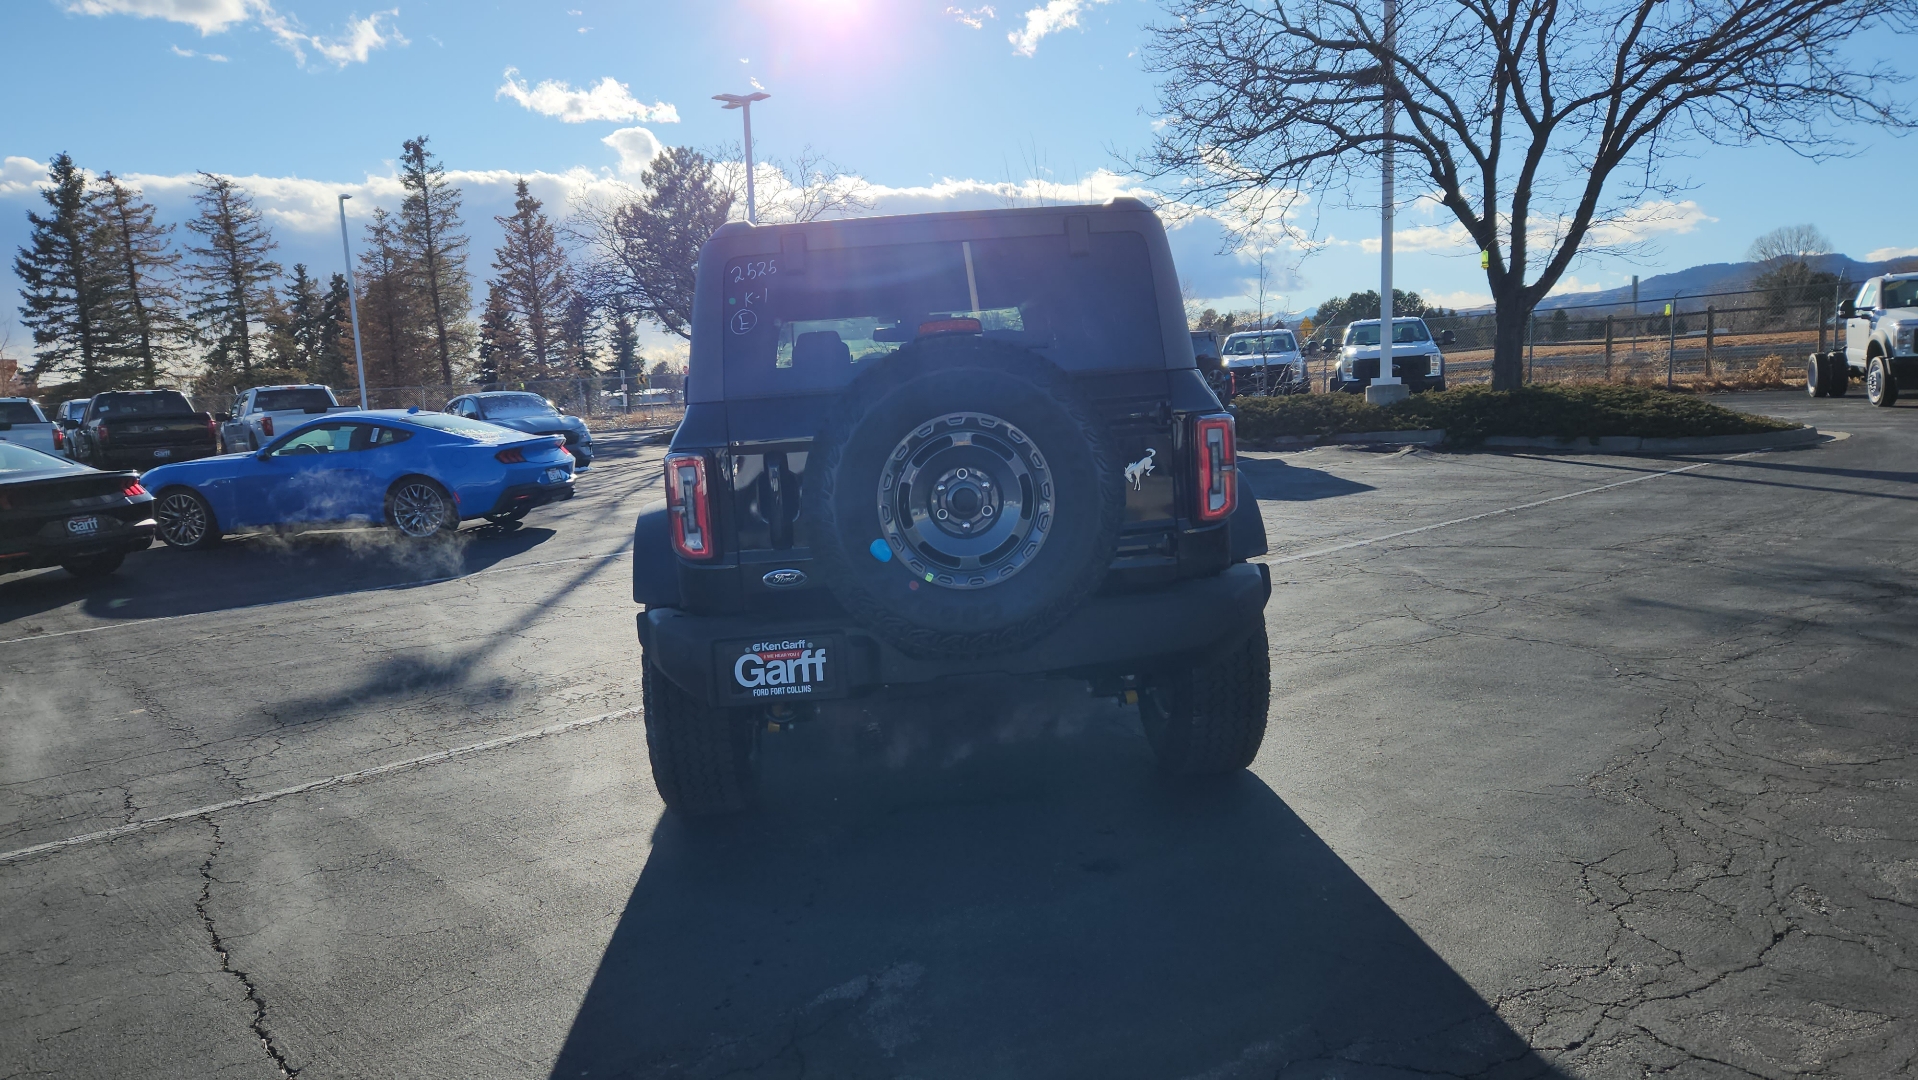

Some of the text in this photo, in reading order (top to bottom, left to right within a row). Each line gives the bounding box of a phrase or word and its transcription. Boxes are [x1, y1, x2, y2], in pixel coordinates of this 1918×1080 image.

[731, 259, 777, 283] 2525
[67, 517, 98, 532] Garff
[773, 573, 797, 583] Ford
[761, 639, 806, 651] Ken Garff
[734, 648, 827, 688] Garff
[753, 685, 812, 697] FORD FORT COLLINS
